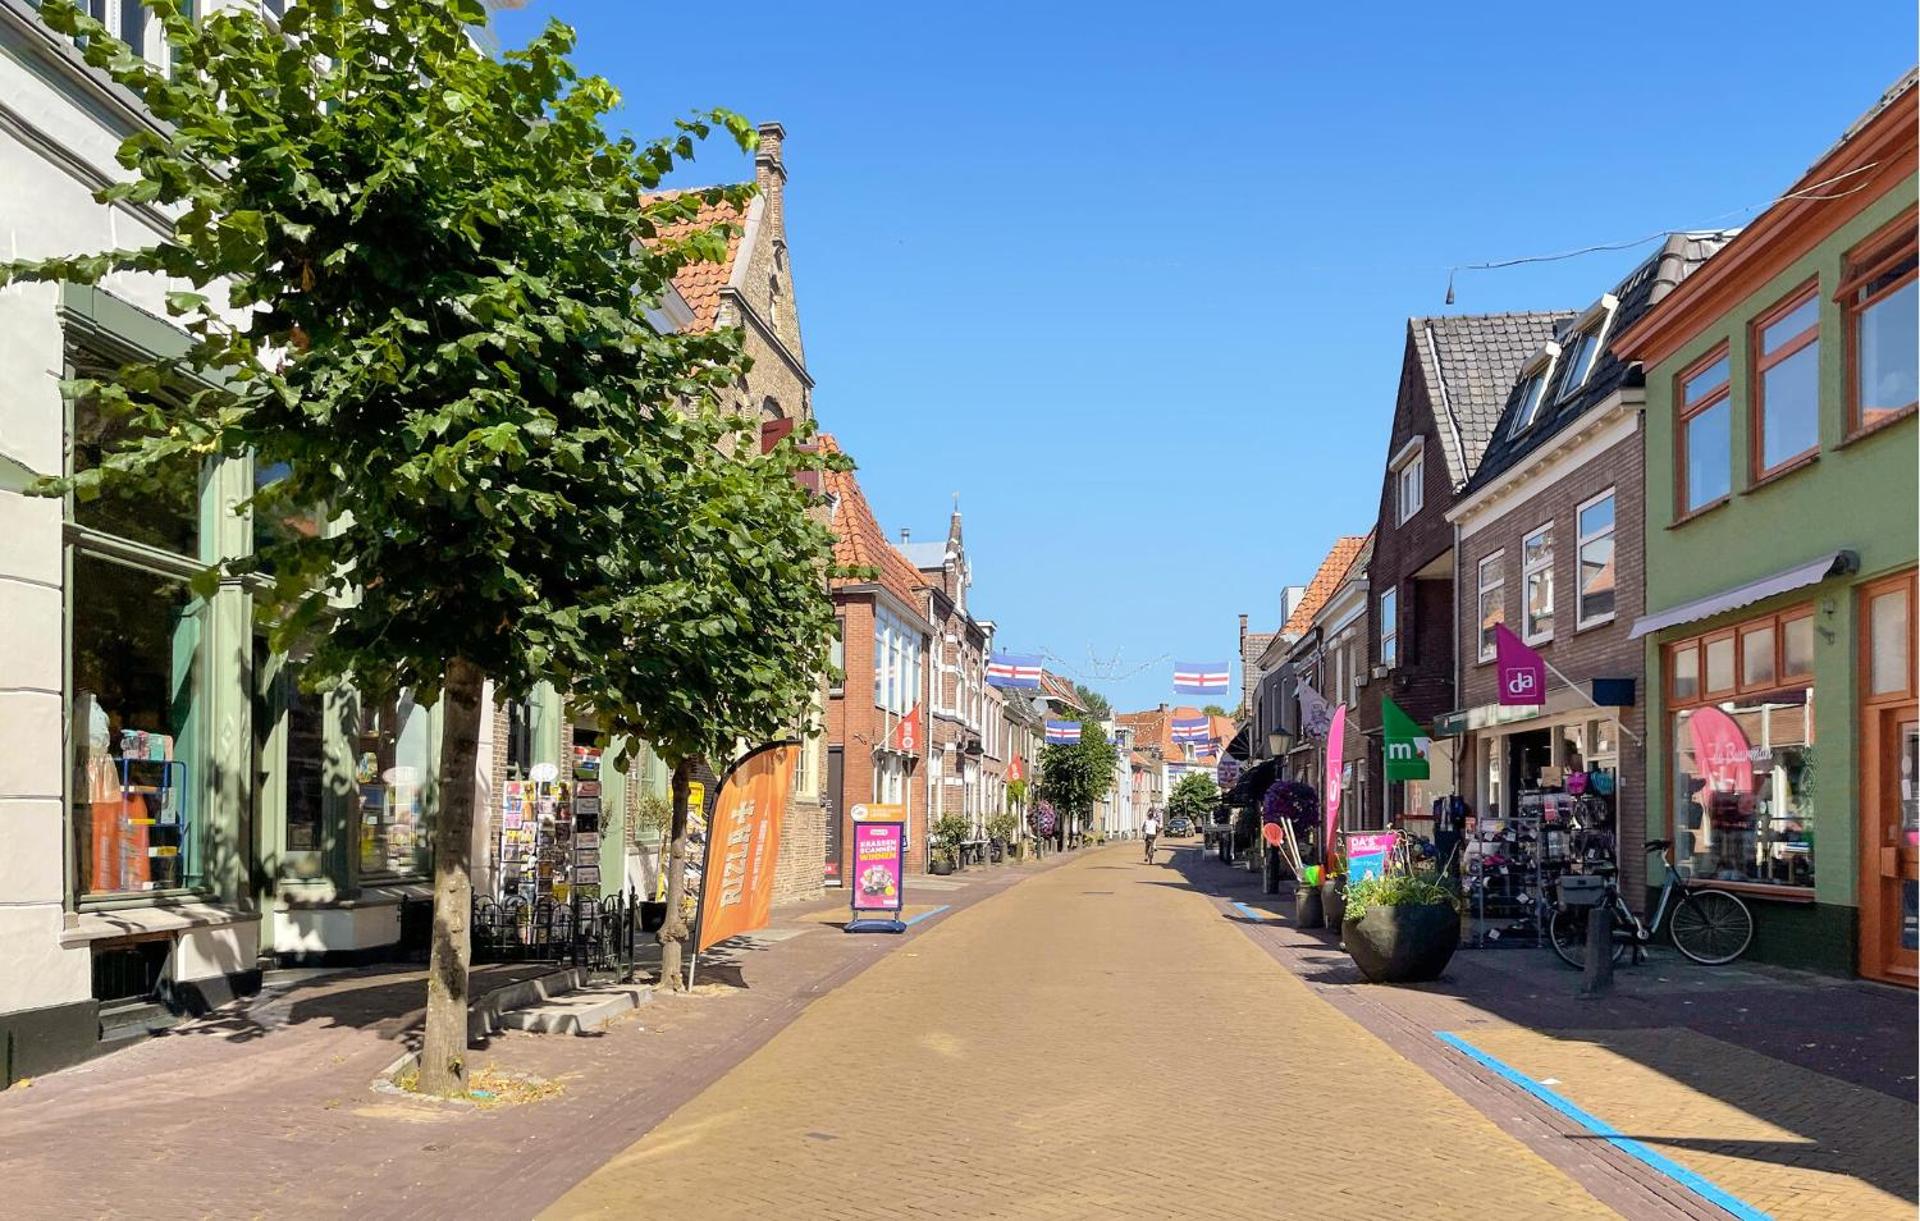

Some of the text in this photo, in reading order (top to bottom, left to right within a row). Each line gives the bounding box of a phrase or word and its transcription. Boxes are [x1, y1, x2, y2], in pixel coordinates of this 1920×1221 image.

[1508, 672, 1534, 694] da
[1389, 743, 1412, 760] m
[859, 839, 897, 849] KRASSEN
[859, 846, 897, 855] SCANNEN
[859, 852, 897, 861] WINNEN
